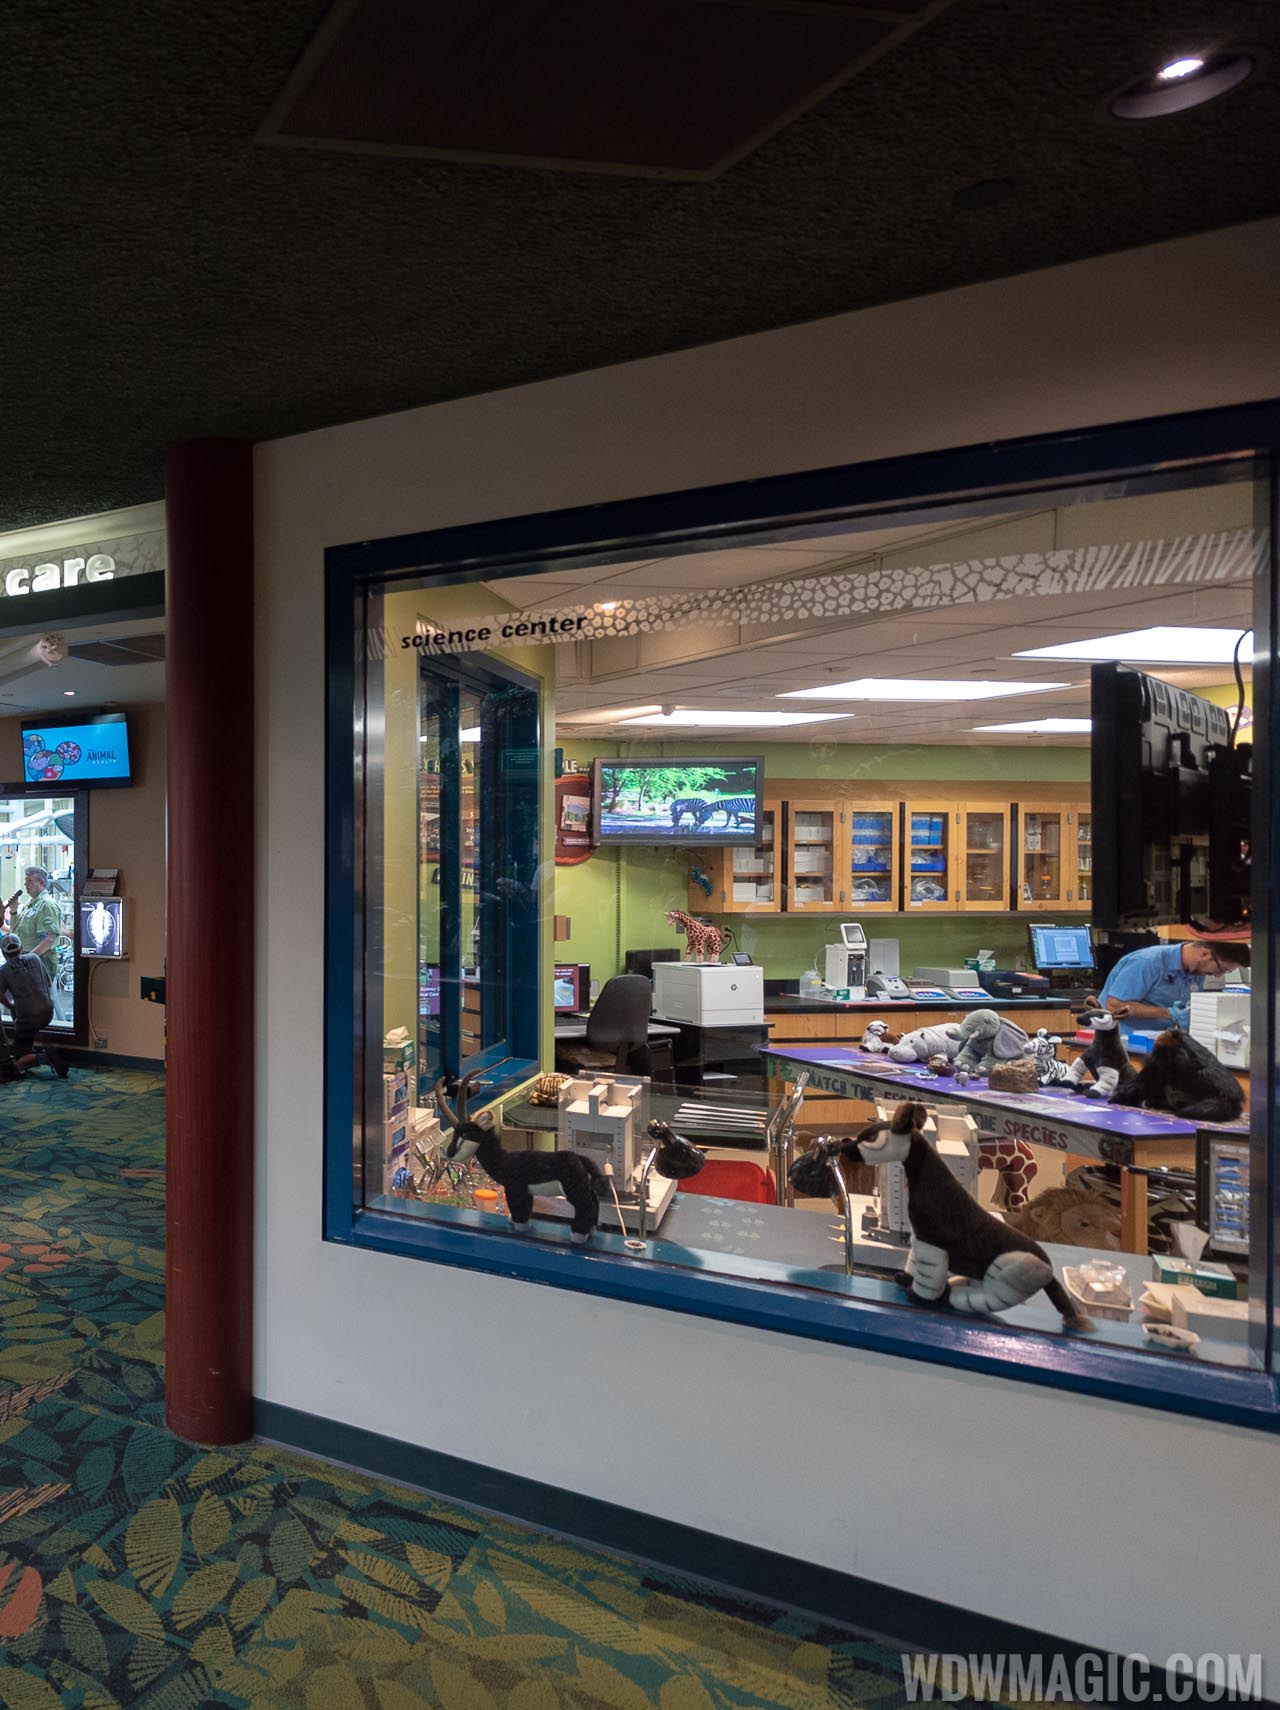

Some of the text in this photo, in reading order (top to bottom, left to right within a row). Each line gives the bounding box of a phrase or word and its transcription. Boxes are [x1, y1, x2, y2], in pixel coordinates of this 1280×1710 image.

[4, 553, 115, 597] care
[401, 615, 588, 649] science center
[86, 751, 117, 762] ANIMAL
[807, 1068, 847, 1095] MATCH
[851, 1083, 875, 1100] THE
[1004, 1119, 1069, 1150] SPECIES
